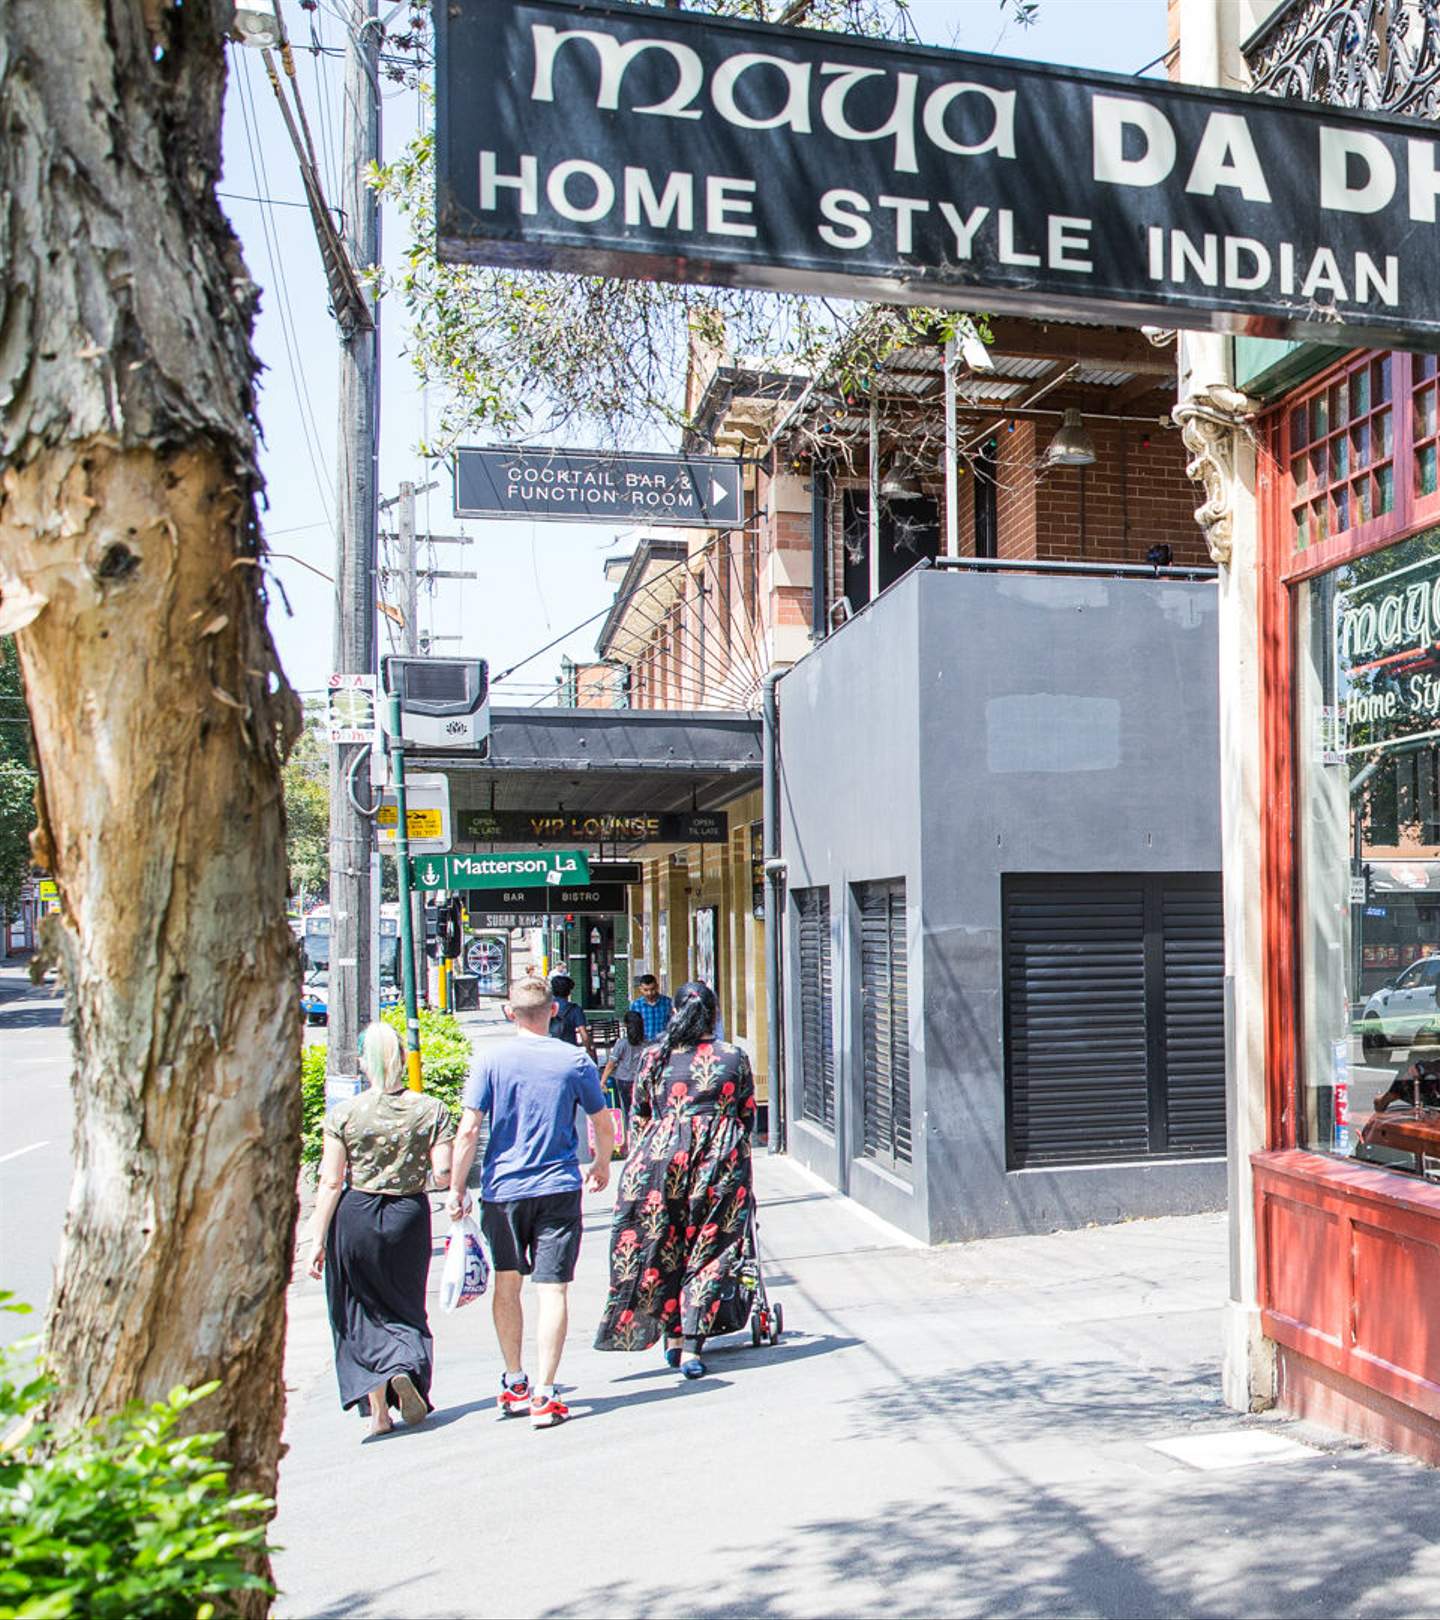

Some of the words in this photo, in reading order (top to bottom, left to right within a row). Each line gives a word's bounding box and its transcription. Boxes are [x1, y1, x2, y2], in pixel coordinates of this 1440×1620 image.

[1093, 95, 1272, 203] DA
[479, 151, 757, 238] HOME
[818, 188, 1093, 273] STYLE
[1148, 227, 1398, 307] INDIAN
[507, 467, 615, 486] COCKTAIL
[626, 473, 667, 488] BAR
[507, 485, 616, 503] FUNCTION
[632, 491, 693, 507] ROOM
[1346, 690, 1397, 725] Home
[530, 818, 565, 836] VIP
[571, 818, 660, 837] LOUNGE
[453, 857, 548, 876] Matterson
[555, 854, 577, 872] La
[503, 892, 525, 901] BAR
[562, 891, 600, 901] BISTRO
[486, 914, 516, 927] SUGAR
